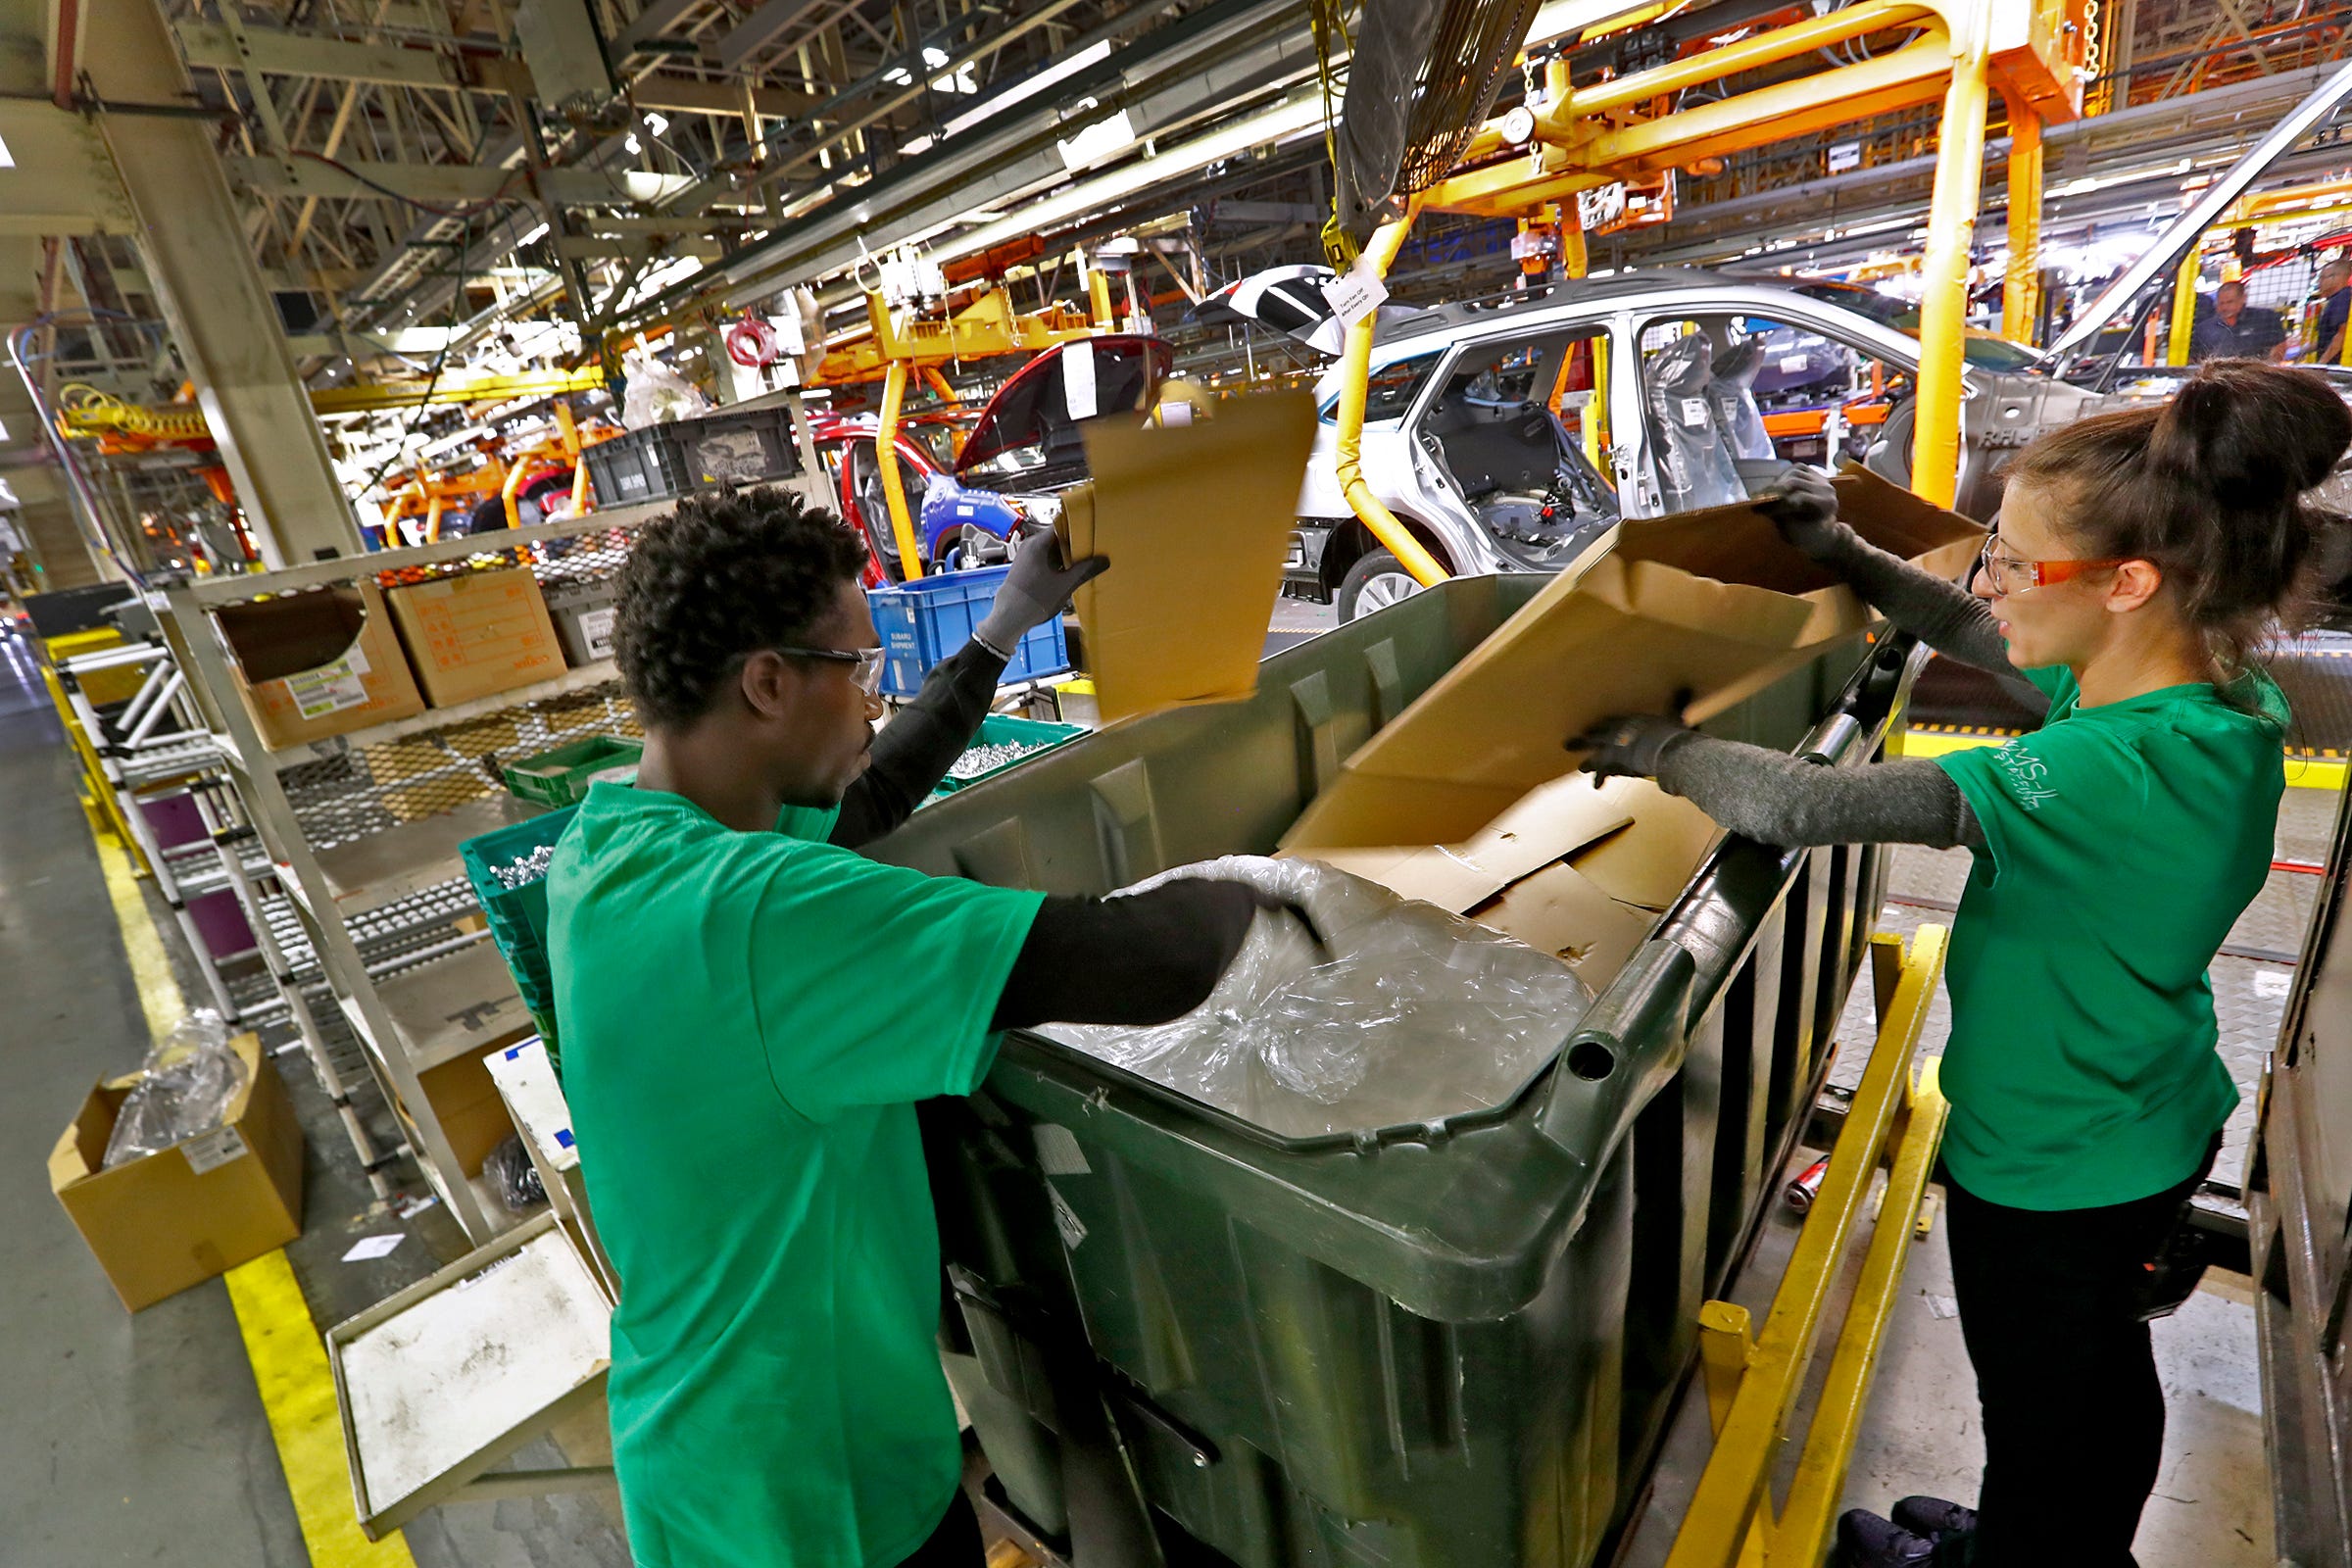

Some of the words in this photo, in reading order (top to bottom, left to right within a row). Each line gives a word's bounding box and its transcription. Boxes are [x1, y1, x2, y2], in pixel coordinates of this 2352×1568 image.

[1340, 300, 1349, 309] Turn
[1342, 308, 1351, 317] After
[1351, 299, 1363, 310] Every
[891, 632, 911, 641] SUBARU
